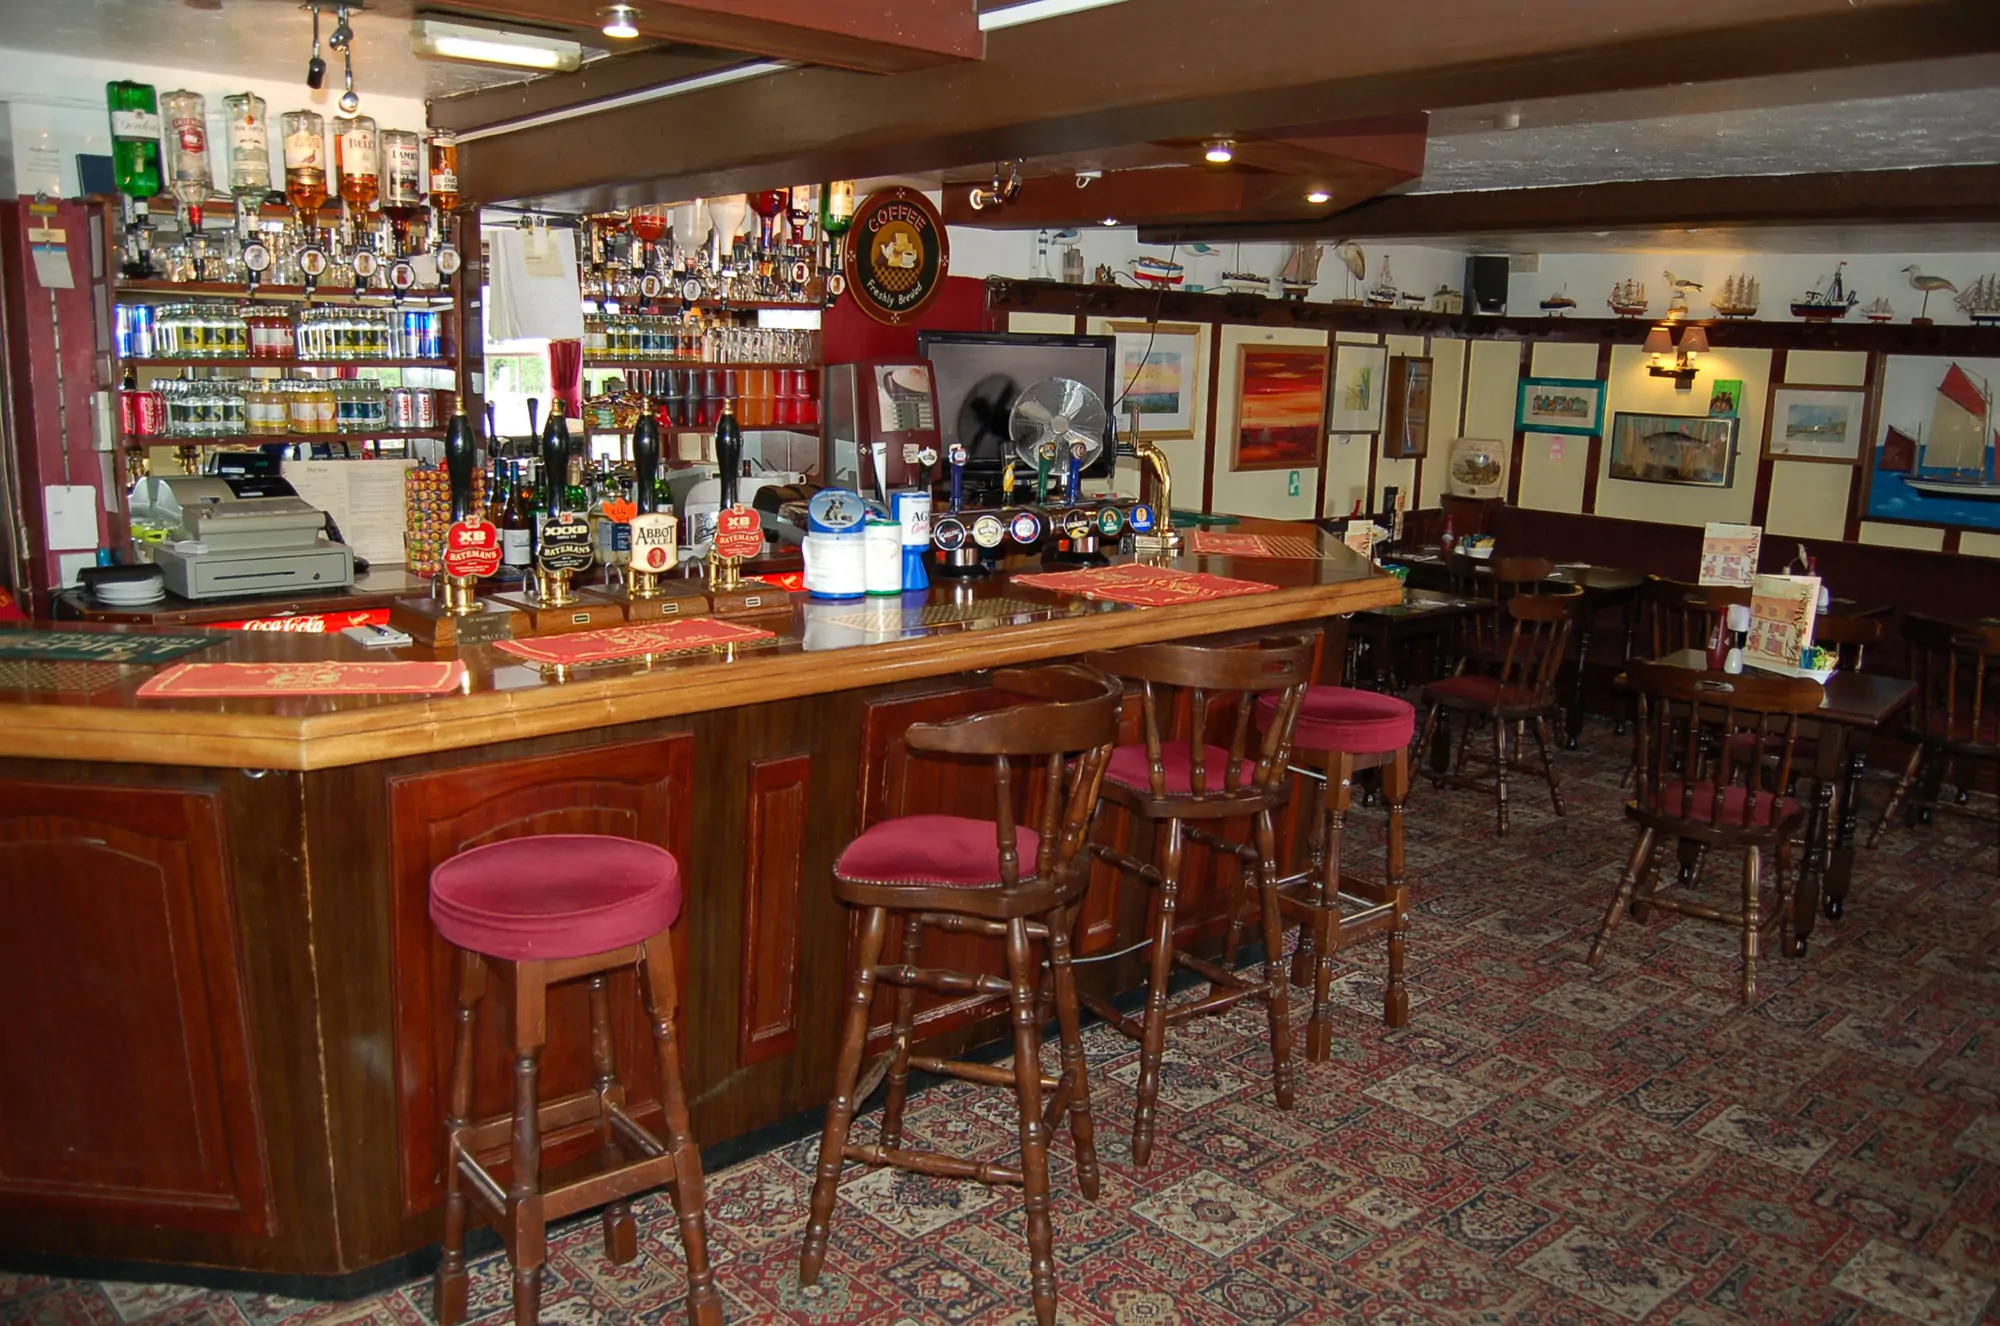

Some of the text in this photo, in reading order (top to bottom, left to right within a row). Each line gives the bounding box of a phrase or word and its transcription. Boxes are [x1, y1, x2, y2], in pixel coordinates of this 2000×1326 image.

[868, 205, 926, 232] COFFEE
[867, 279, 923, 308] Freshly Brewed
[727, 517, 750, 527] XB
[545, 525, 588, 536] XXXB
[635, 525, 674, 546] ABBOT
[459, 531, 487, 542] XB
[649, 538, 669, 546] ALE
